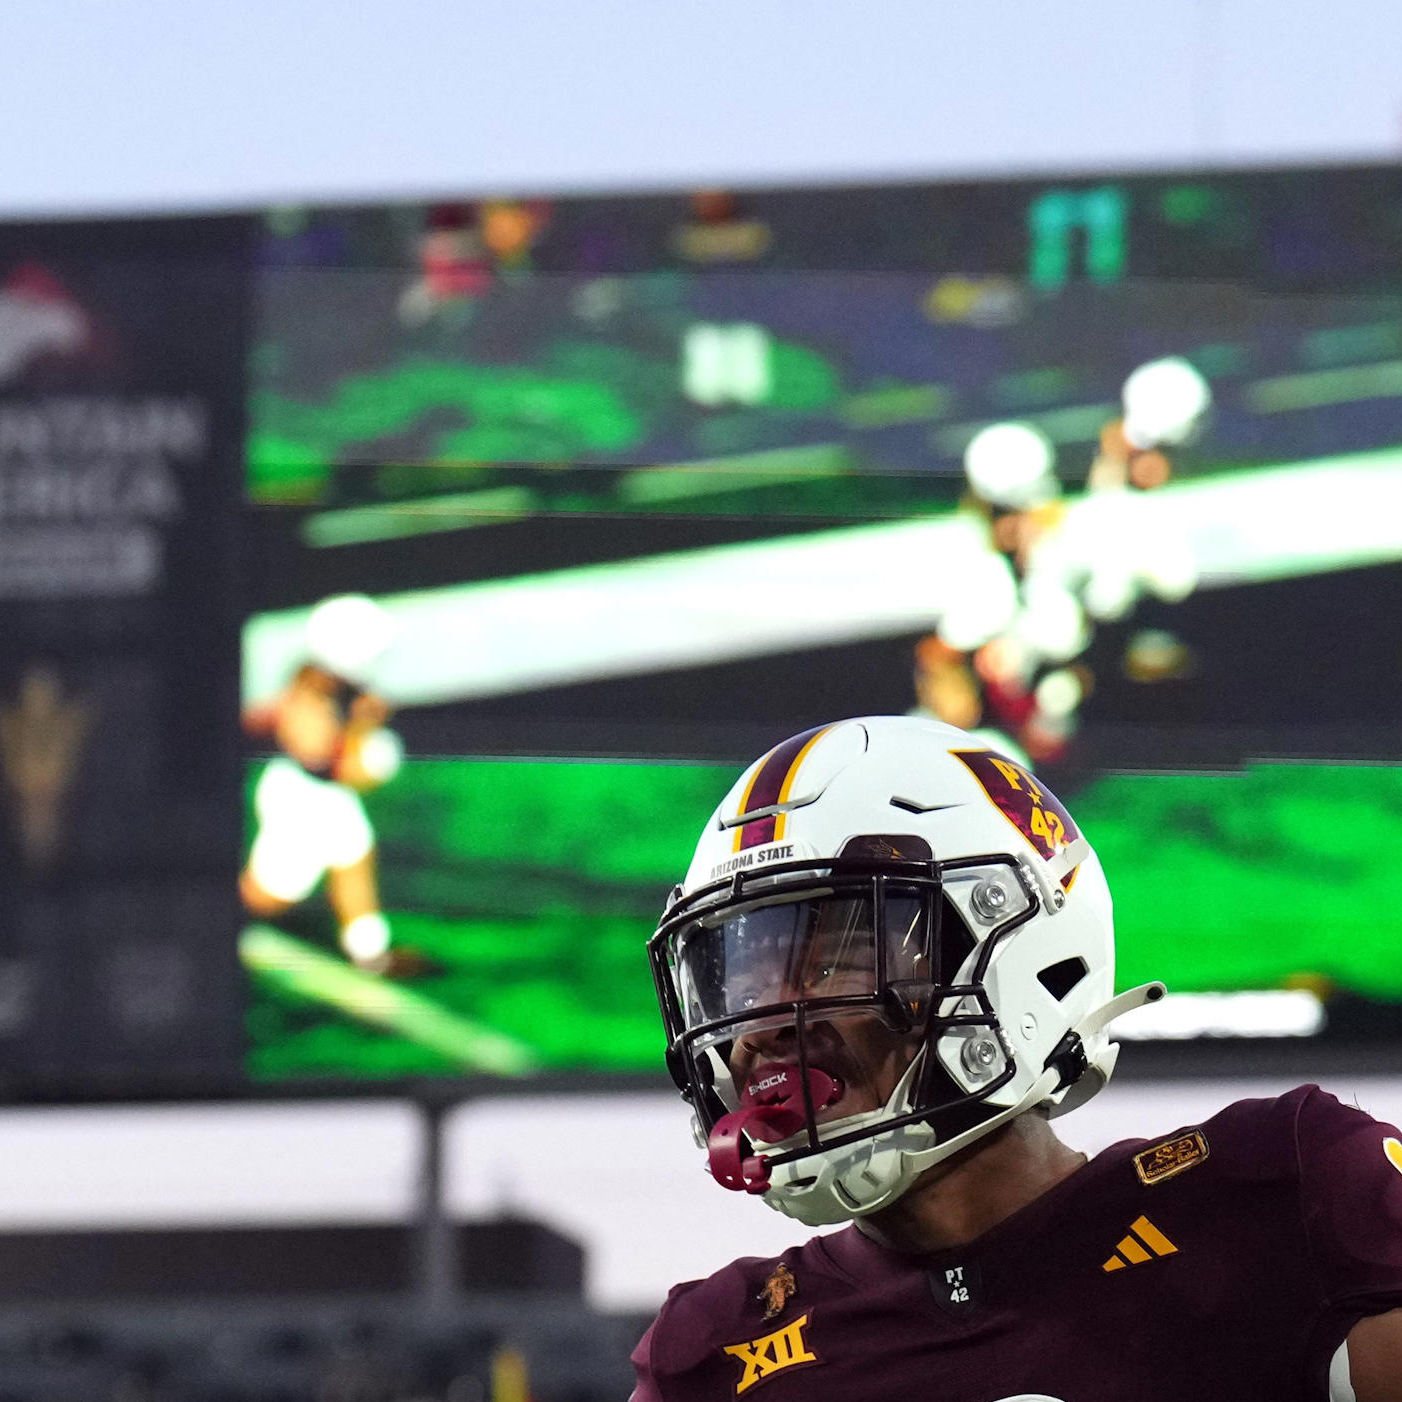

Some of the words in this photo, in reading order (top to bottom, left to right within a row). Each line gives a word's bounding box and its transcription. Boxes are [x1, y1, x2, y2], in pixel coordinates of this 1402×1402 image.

[987, 757, 1044, 797] PT
[1030, 806, 1070, 851] 42
[710, 853, 753, 880] ARIZONA
[757, 844, 794, 864] STATE
[748, 1072, 788, 1096] SHOCK
[945, 1266, 963, 1284] PT
[950, 1287, 970, 1303] 42
[723, 1314, 817, 1395] XII
